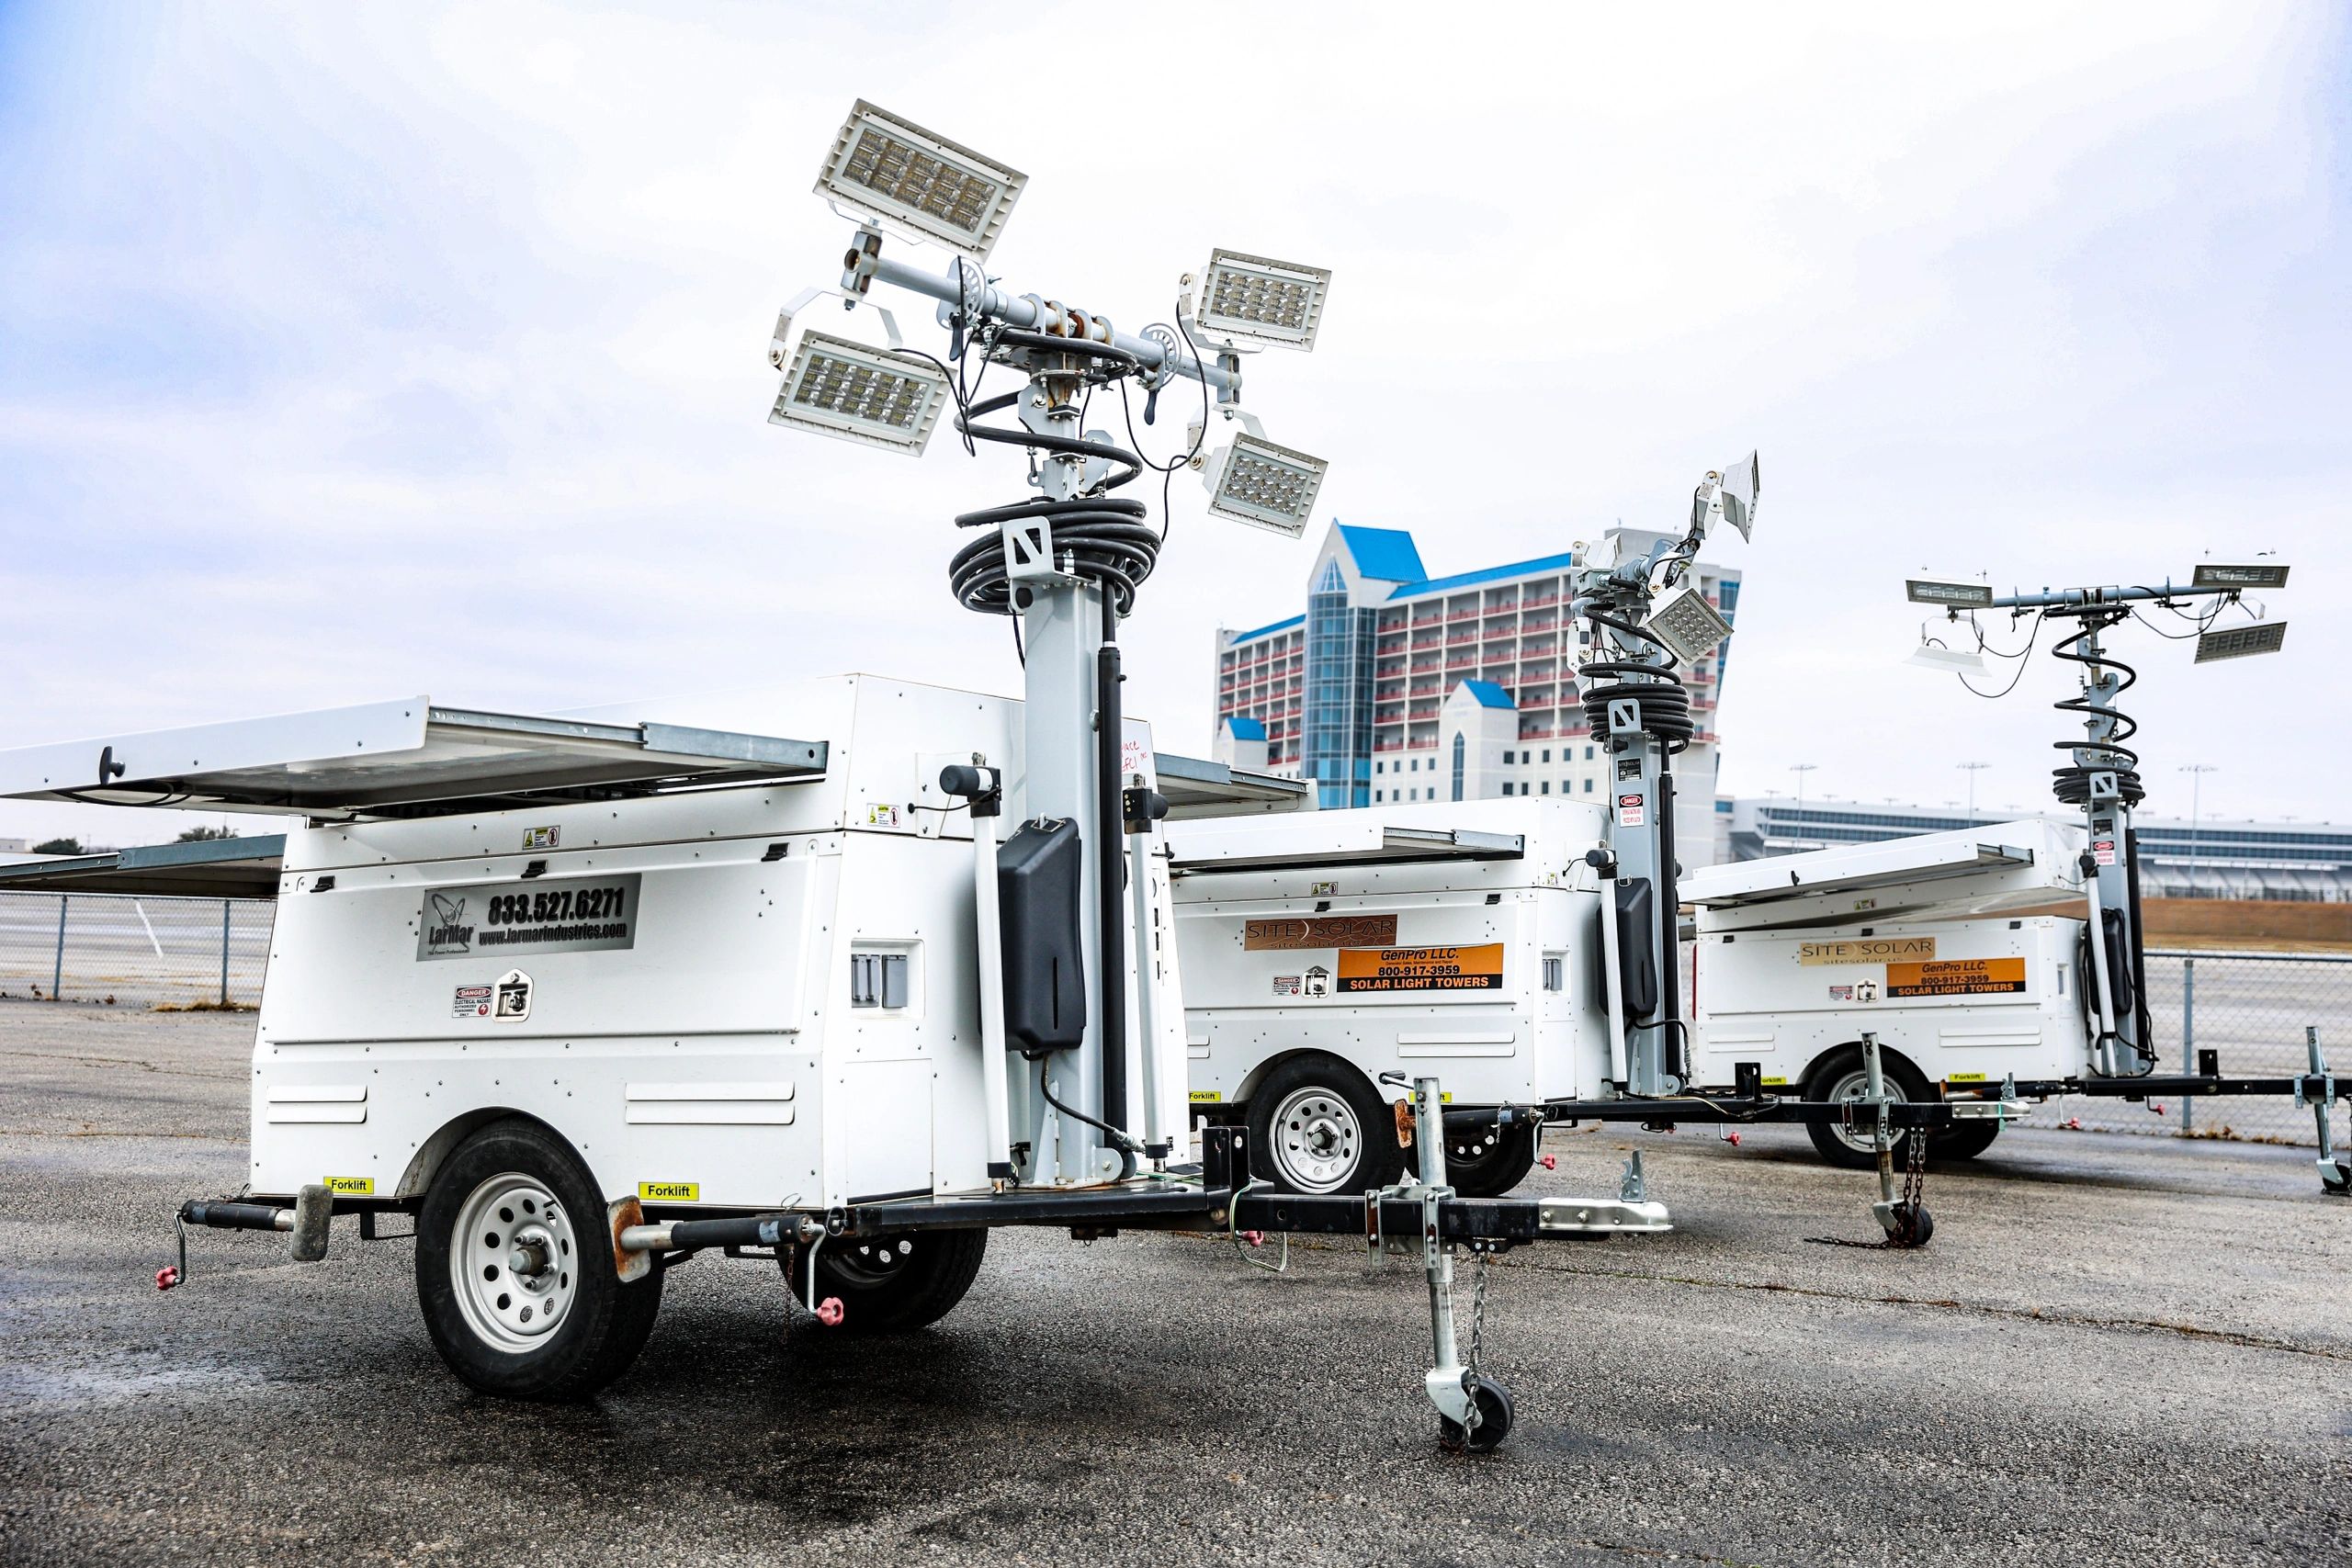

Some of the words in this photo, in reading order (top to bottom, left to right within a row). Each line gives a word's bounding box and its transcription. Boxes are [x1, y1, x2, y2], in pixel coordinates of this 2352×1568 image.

[488, 886, 626, 926] 833.527.6271
[429, 924, 474, 945] LarMar
[479, 921, 628, 946] www.larmarindustries.com
[1248, 923, 1297, 938] SITE
[1314, 919, 1393, 936] SOLAR
[1381, 948, 1428, 961] GenPro
[1430, 947, 1460, 960] LLC.
[1803, 944, 1847, 957] SITE
[1861, 942, 1932, 954] SOLAR
[1378, 964, 1461, 976] 800-917-3959
[1922, 963, 1961, 973] GenPro
[1963, 961, 1988, 972] LLC.
[1350, 979, 1390, 990] SOLAR
[1395, 978, 1432, 989] LIGHT
[1436, 976, 1489, 987] TOWERS
[1921, 975, 1989, 985] 800-917-3959
[461, 988, 487, 997] DANGER
[1897, 986, 1932, 996] SOLAR
[1935, 985, 1967, 994] LIGHT
[1969, 983, 2015, 993] TOWERS
[331, 1179, 367, 1190] Forklift
[648, 1185, 690, 1197] Forklift
